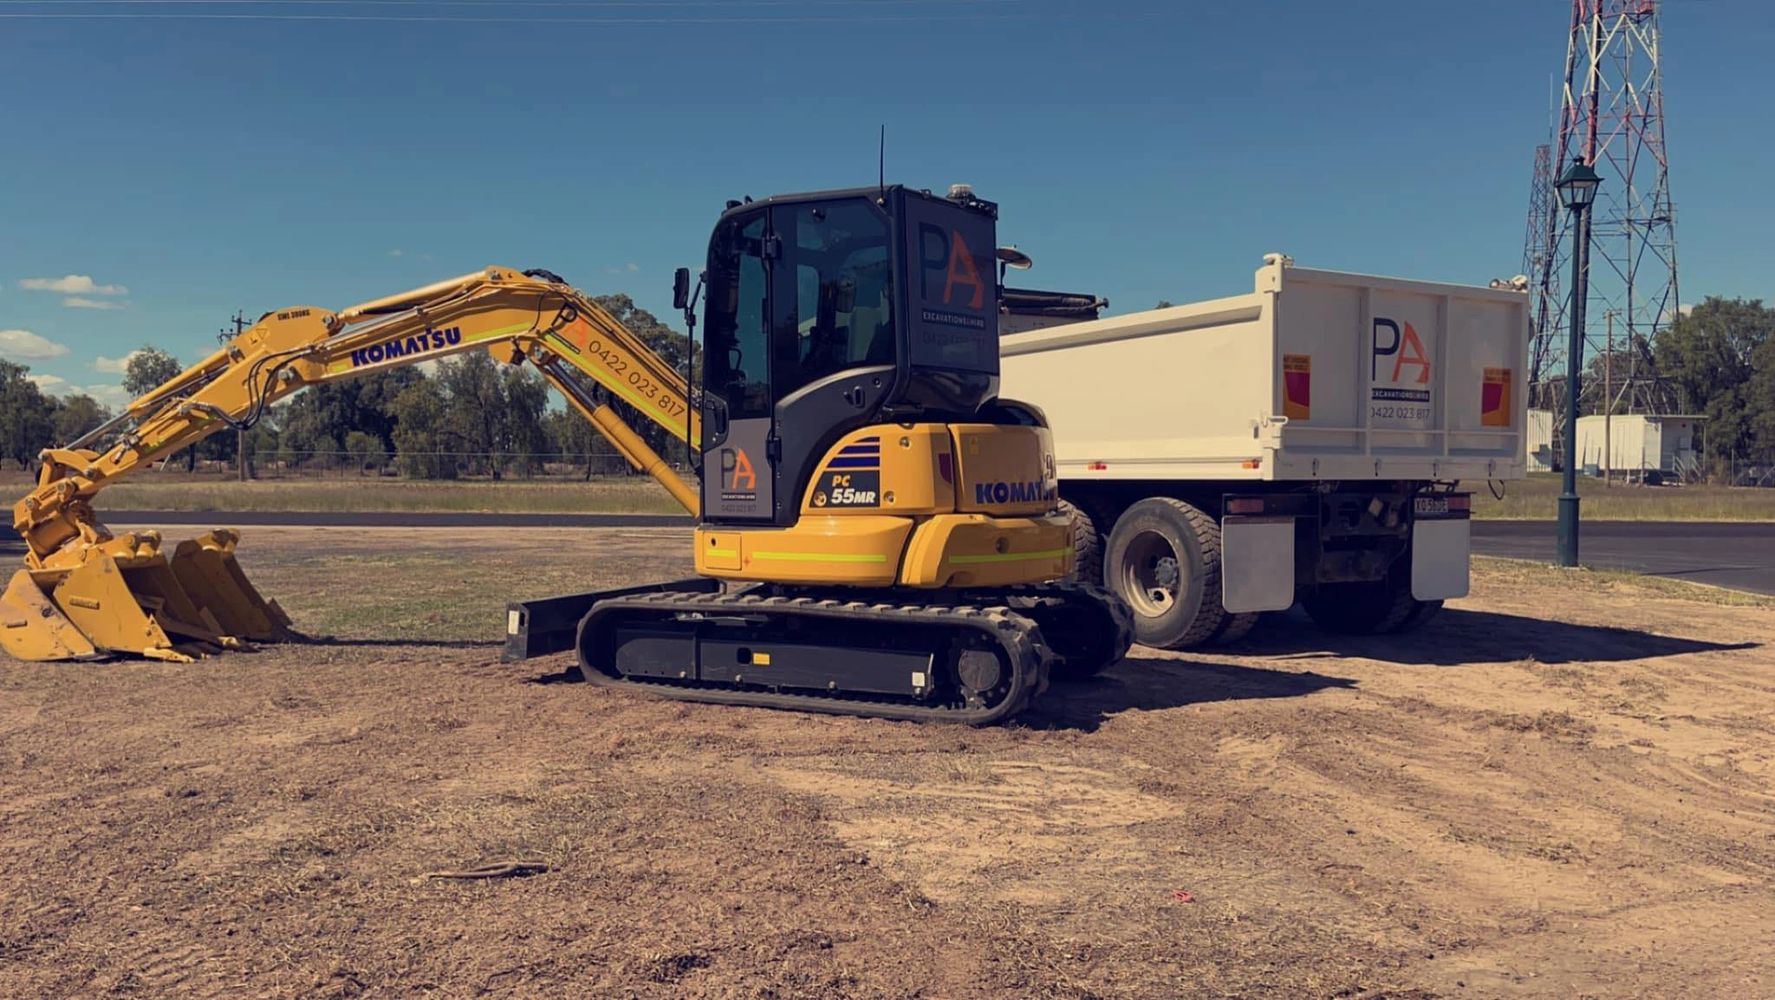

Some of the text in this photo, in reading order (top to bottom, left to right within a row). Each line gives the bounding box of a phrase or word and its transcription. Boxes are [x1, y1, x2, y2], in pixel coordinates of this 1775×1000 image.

[919, 221, 985, 310] PA
[351, 327, 461, 367] KOMATSU
[1372, 317, 1431, 384] PA
[588, 340, 628, 376] 0422
[628, 371, 659, 399] 023
[658, 394, 686, 417] 817
[1396, 407, 1415, 419] 023
[721, 447, 756, 491] PA
[832, 475, 851, 488] PC
[831, 489, 876, 504] 55MR
